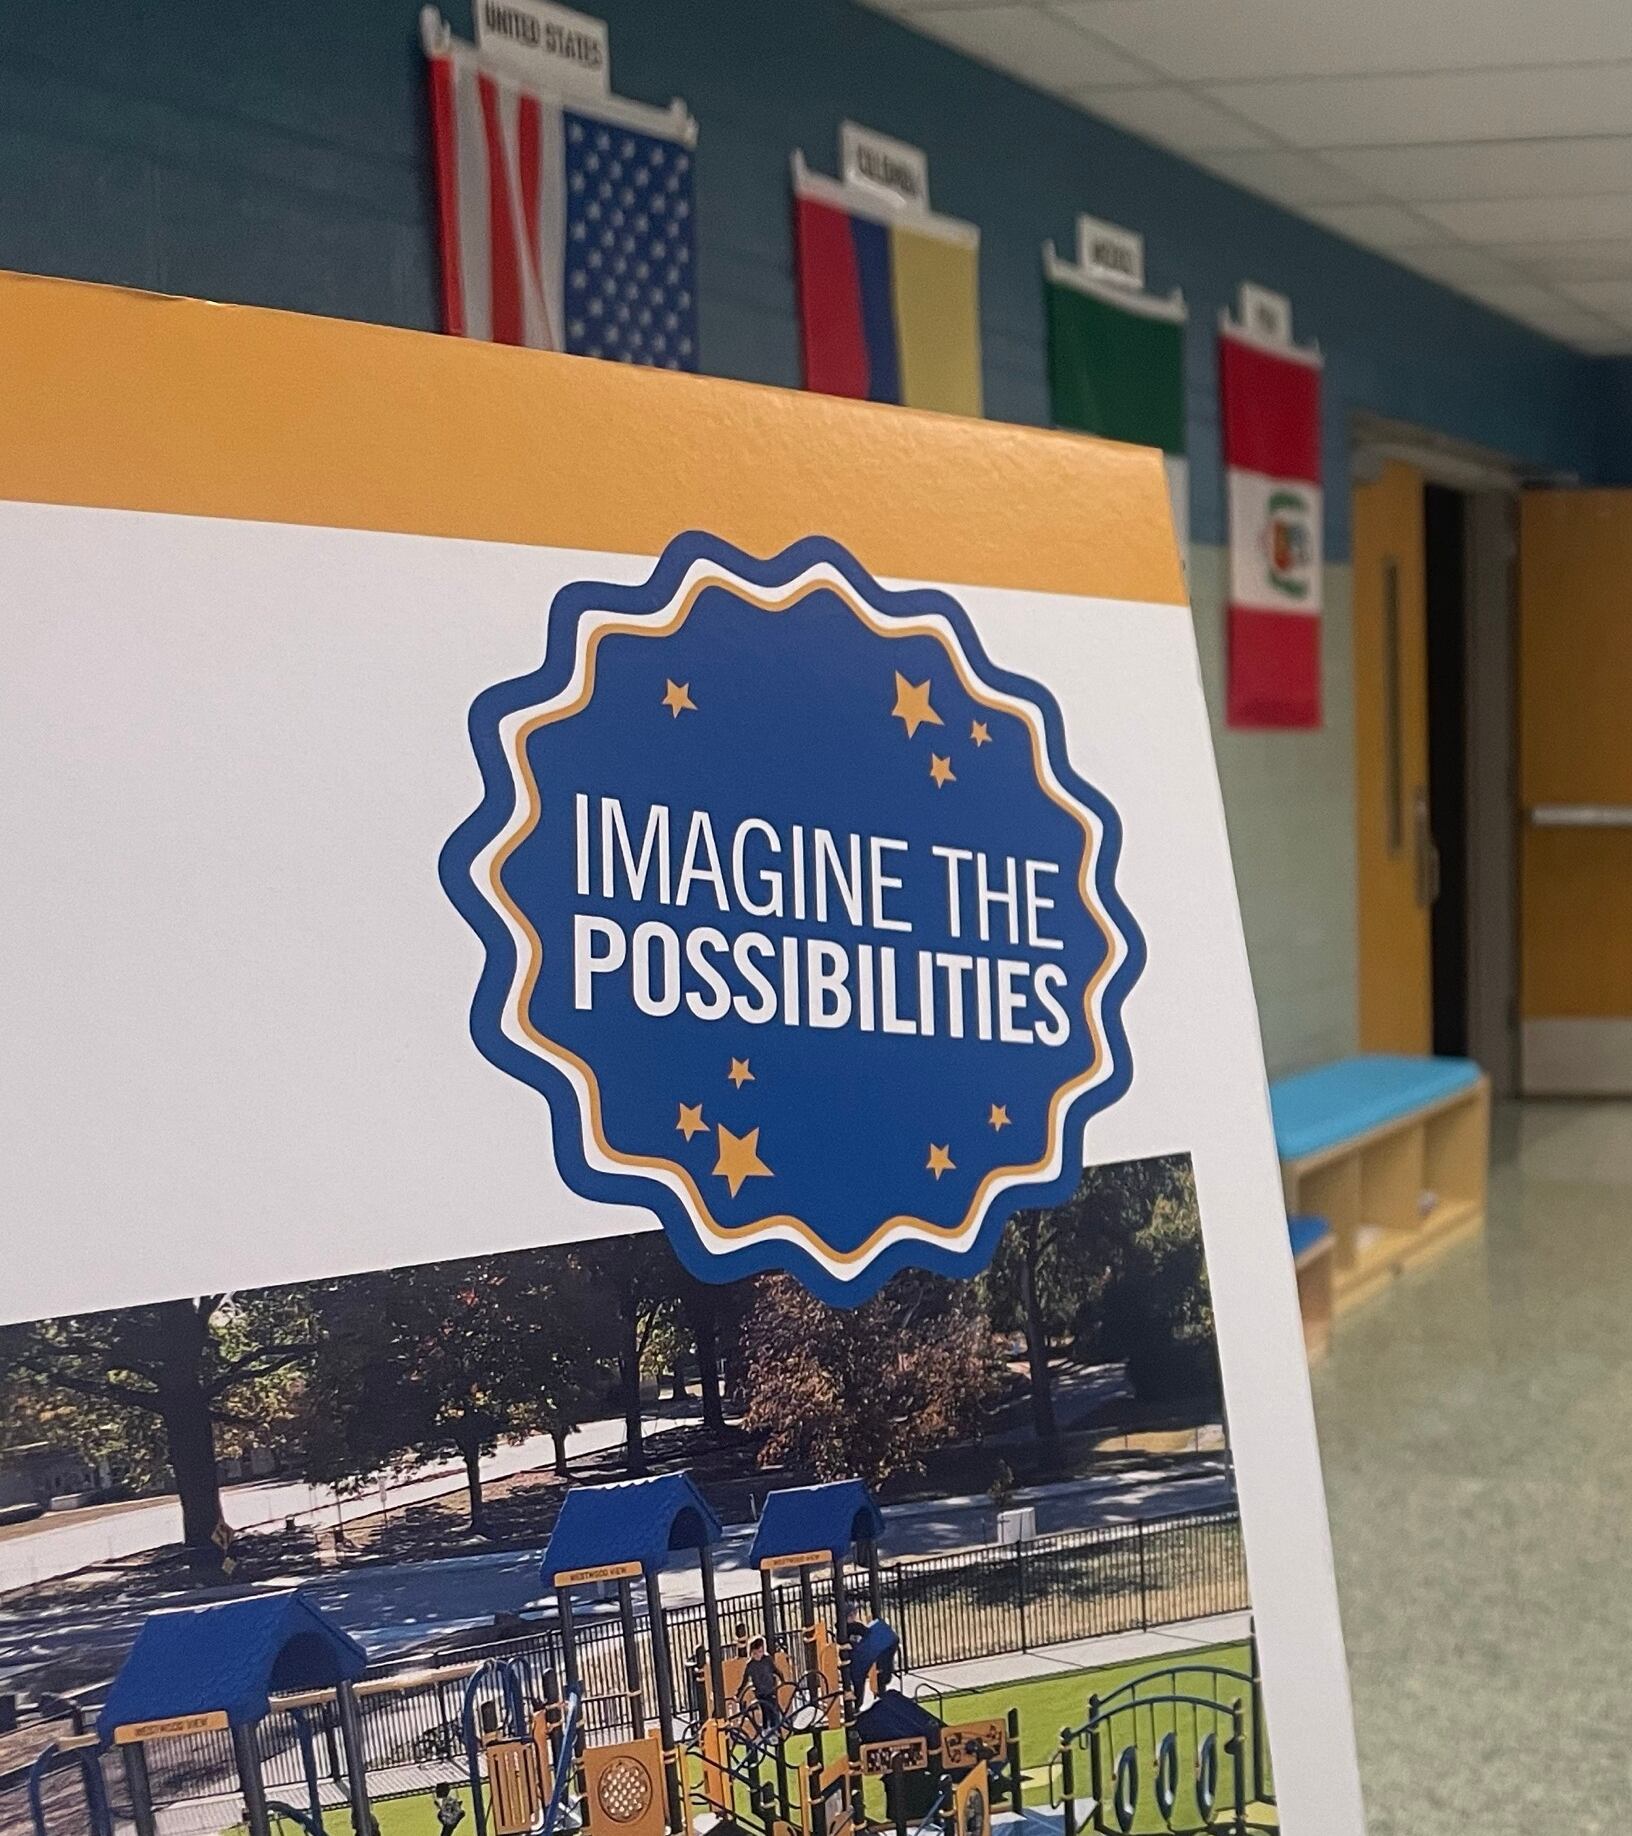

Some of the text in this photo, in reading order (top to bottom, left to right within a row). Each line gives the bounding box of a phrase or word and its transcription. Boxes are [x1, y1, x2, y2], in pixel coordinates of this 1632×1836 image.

[485, 0, 602, 70] UNITED STATES
[575, 792, 1065, 951] IMAGINE THE
[574, 914, 1071, 1047] POSSIBILITIES
[610, 1566, 627, 1576] VIEW
